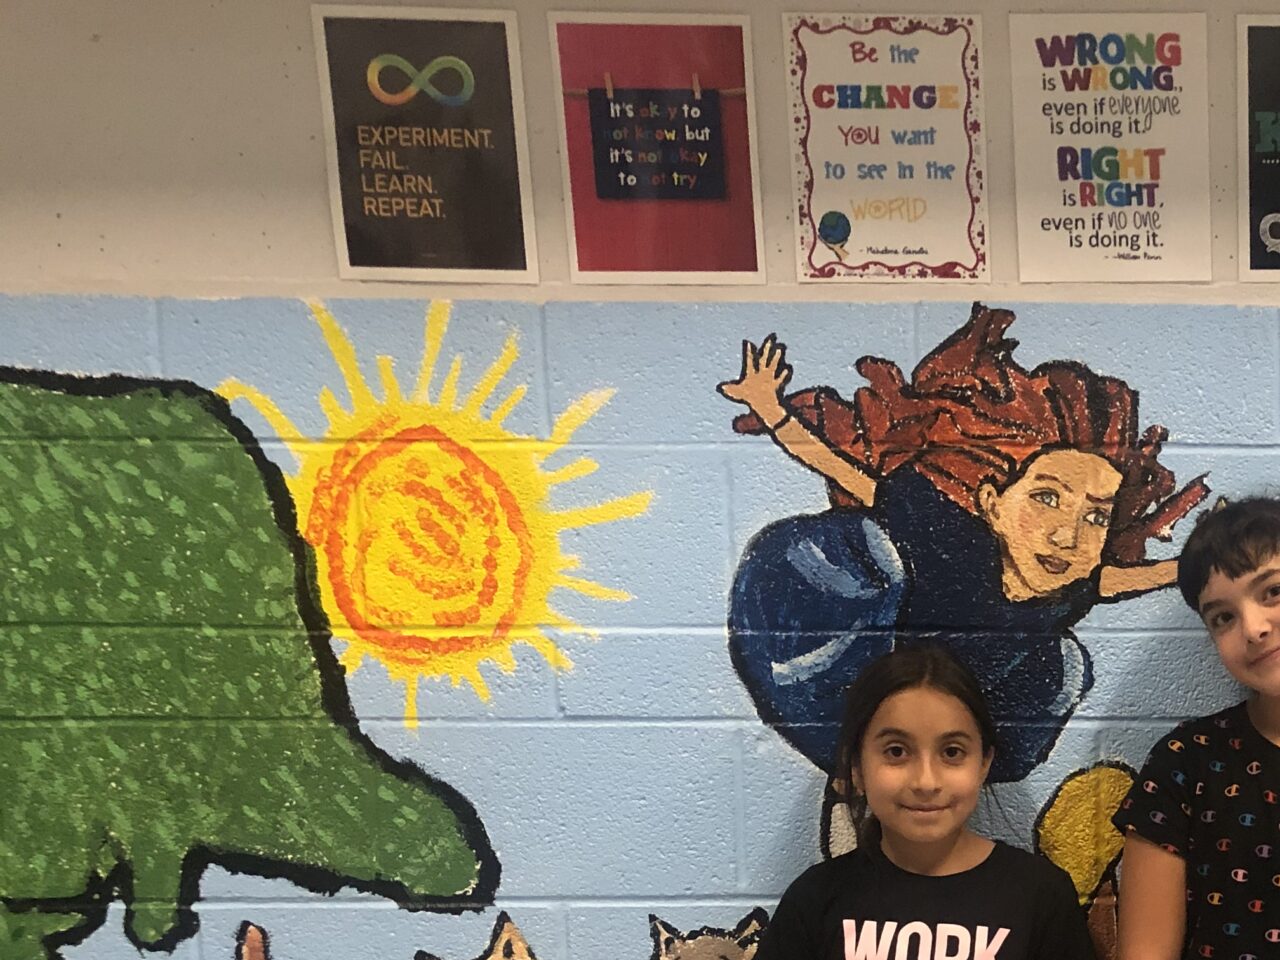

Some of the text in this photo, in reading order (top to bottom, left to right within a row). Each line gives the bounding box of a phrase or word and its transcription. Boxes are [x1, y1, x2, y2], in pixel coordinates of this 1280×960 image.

[849, 41, 919, 64] Be the
[1035, 32, 1182, 68] WRONG
[1042, 73, 1056, 91] is
[812, 84, 961, 110] CHANGE
[610, 101, 701, 120] It's oky to
[1042, 94, 1181, 131] even if everyone
[357, 125, 495, 149] EXPERIMENT.
[685, 124, 710, 141] but
[891, 126, 937, 146] want
[1050, 117, 1146, 138] is doing it.
[359, 149, 409, 170] FAIL.
[609, 147, 633, 163] it's
[672, 147, 707, 166] kay
[1057, 146, 1166, 182] RIGHT
[618, 171, 637, 186] to
[824, 161, 846, 180] to
[857, 163, 887, 180] see
[926, 161, 955, 180] the
[361, 173, 438, 194] LEARN.
[1063, 180, 1164, 208] is RIGHT,
[363, 197, 446, 218] REPEAT.
[1041, 211, 1162, 231] even if no one
[1069, 230, 1164, 251] is doing it.
